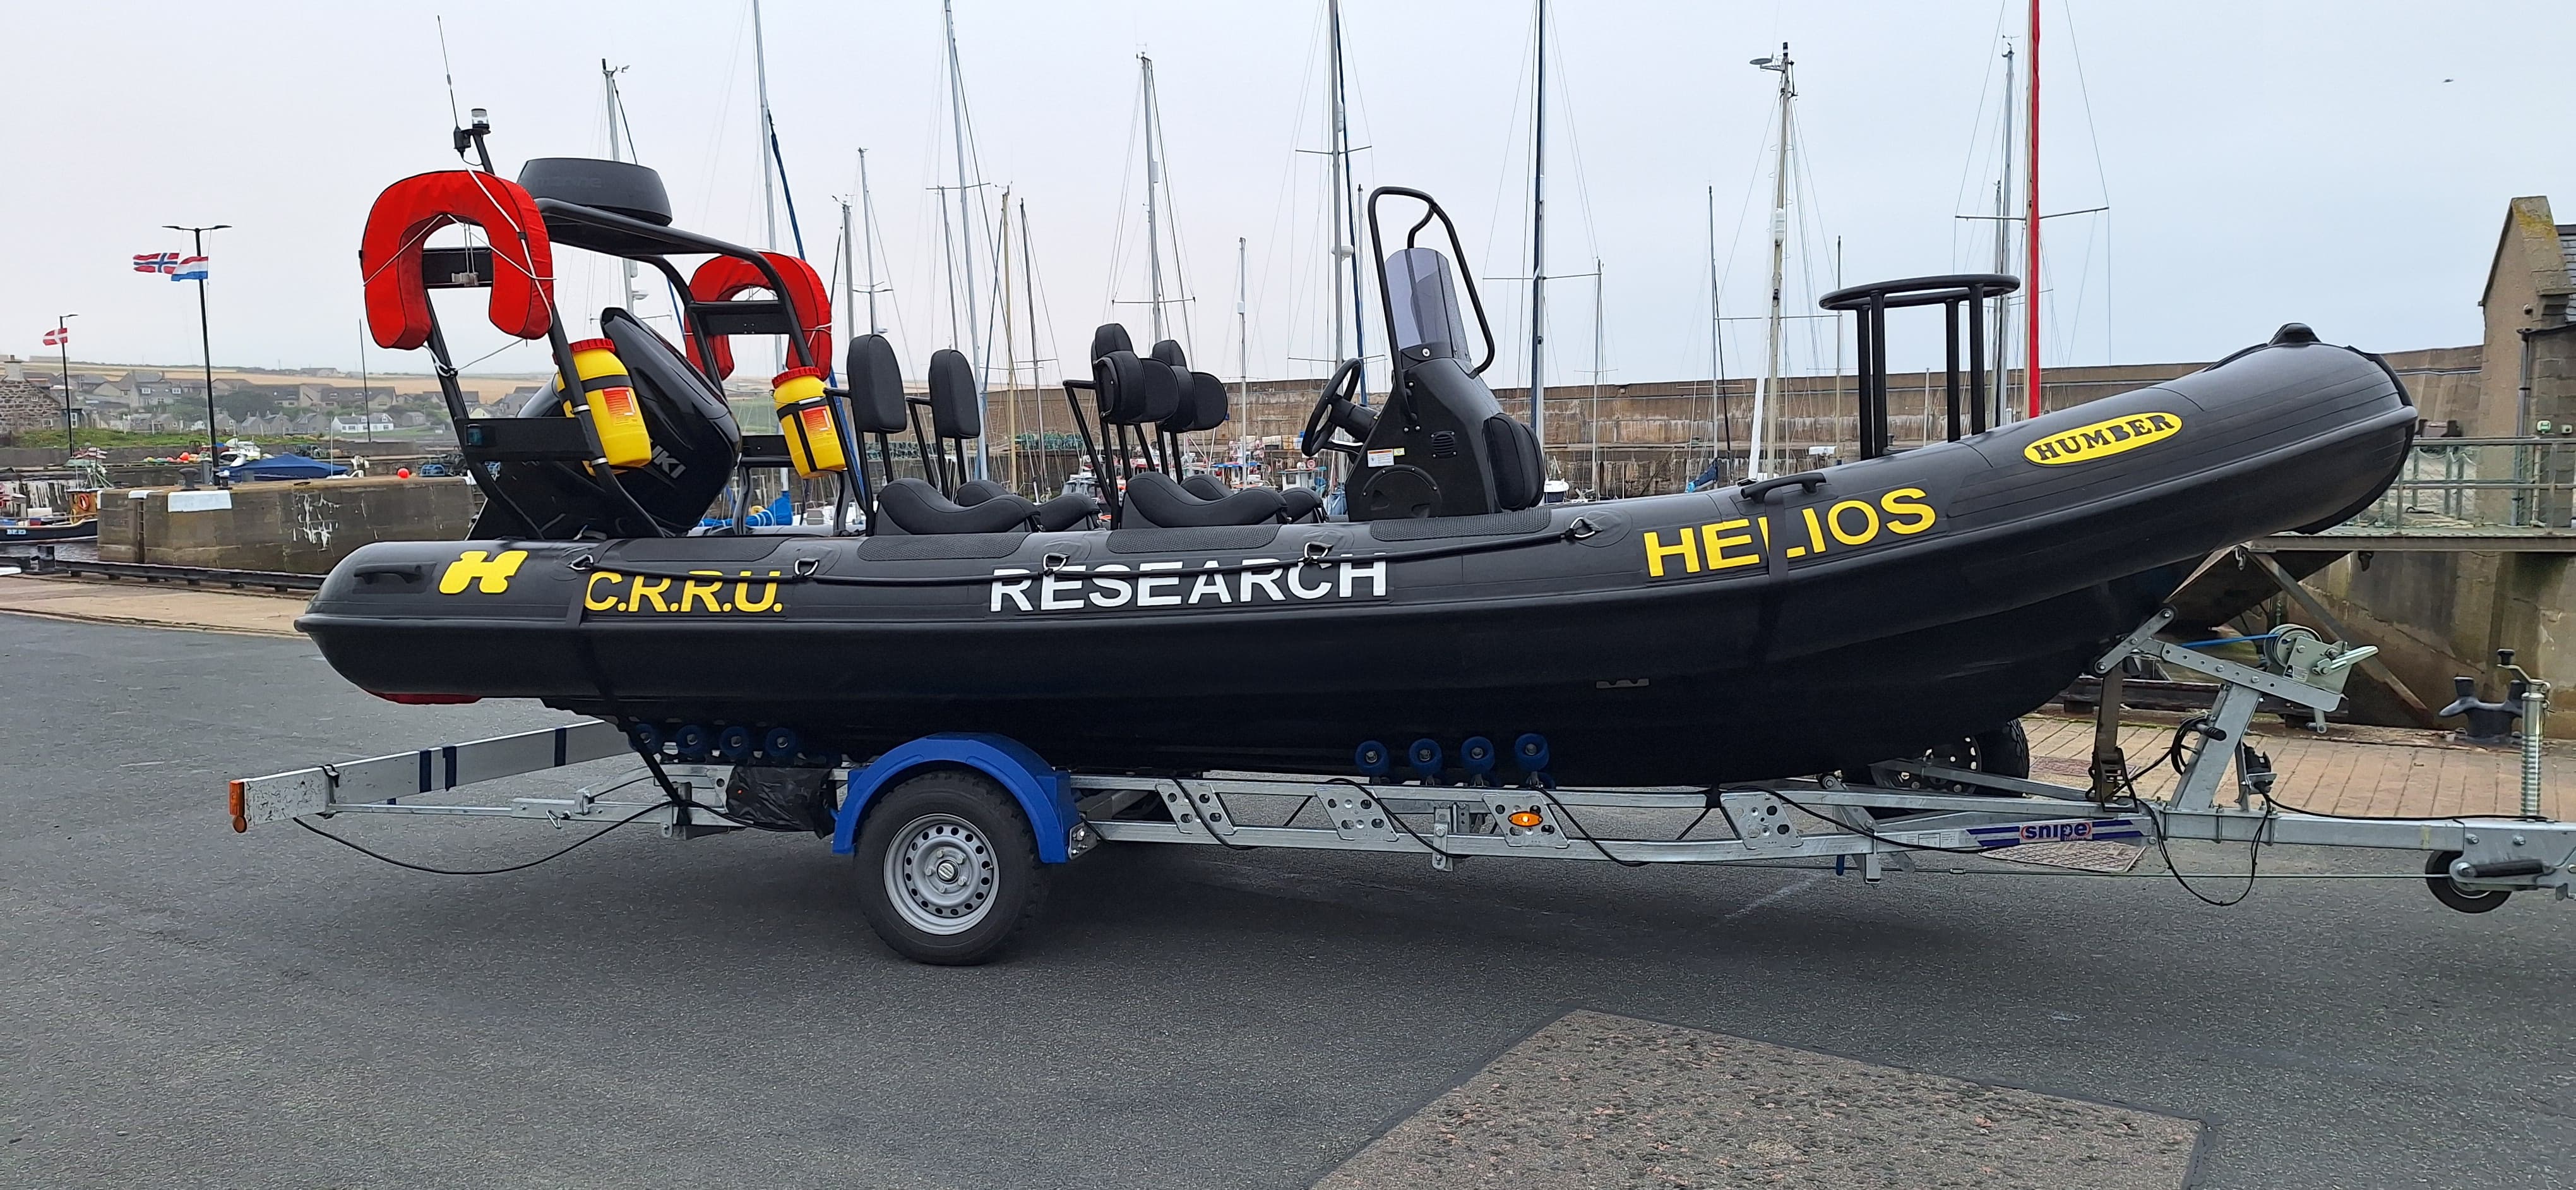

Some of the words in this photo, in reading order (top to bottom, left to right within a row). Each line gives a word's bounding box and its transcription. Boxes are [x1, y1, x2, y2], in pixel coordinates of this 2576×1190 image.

[2032, 415, 2175, 460] HUMBER
[584, 570, 784, 612] C.R.R.U.
[989, 553, 1386, 612] RESEARCH
[2024, 822, 2087, 841] snipe
